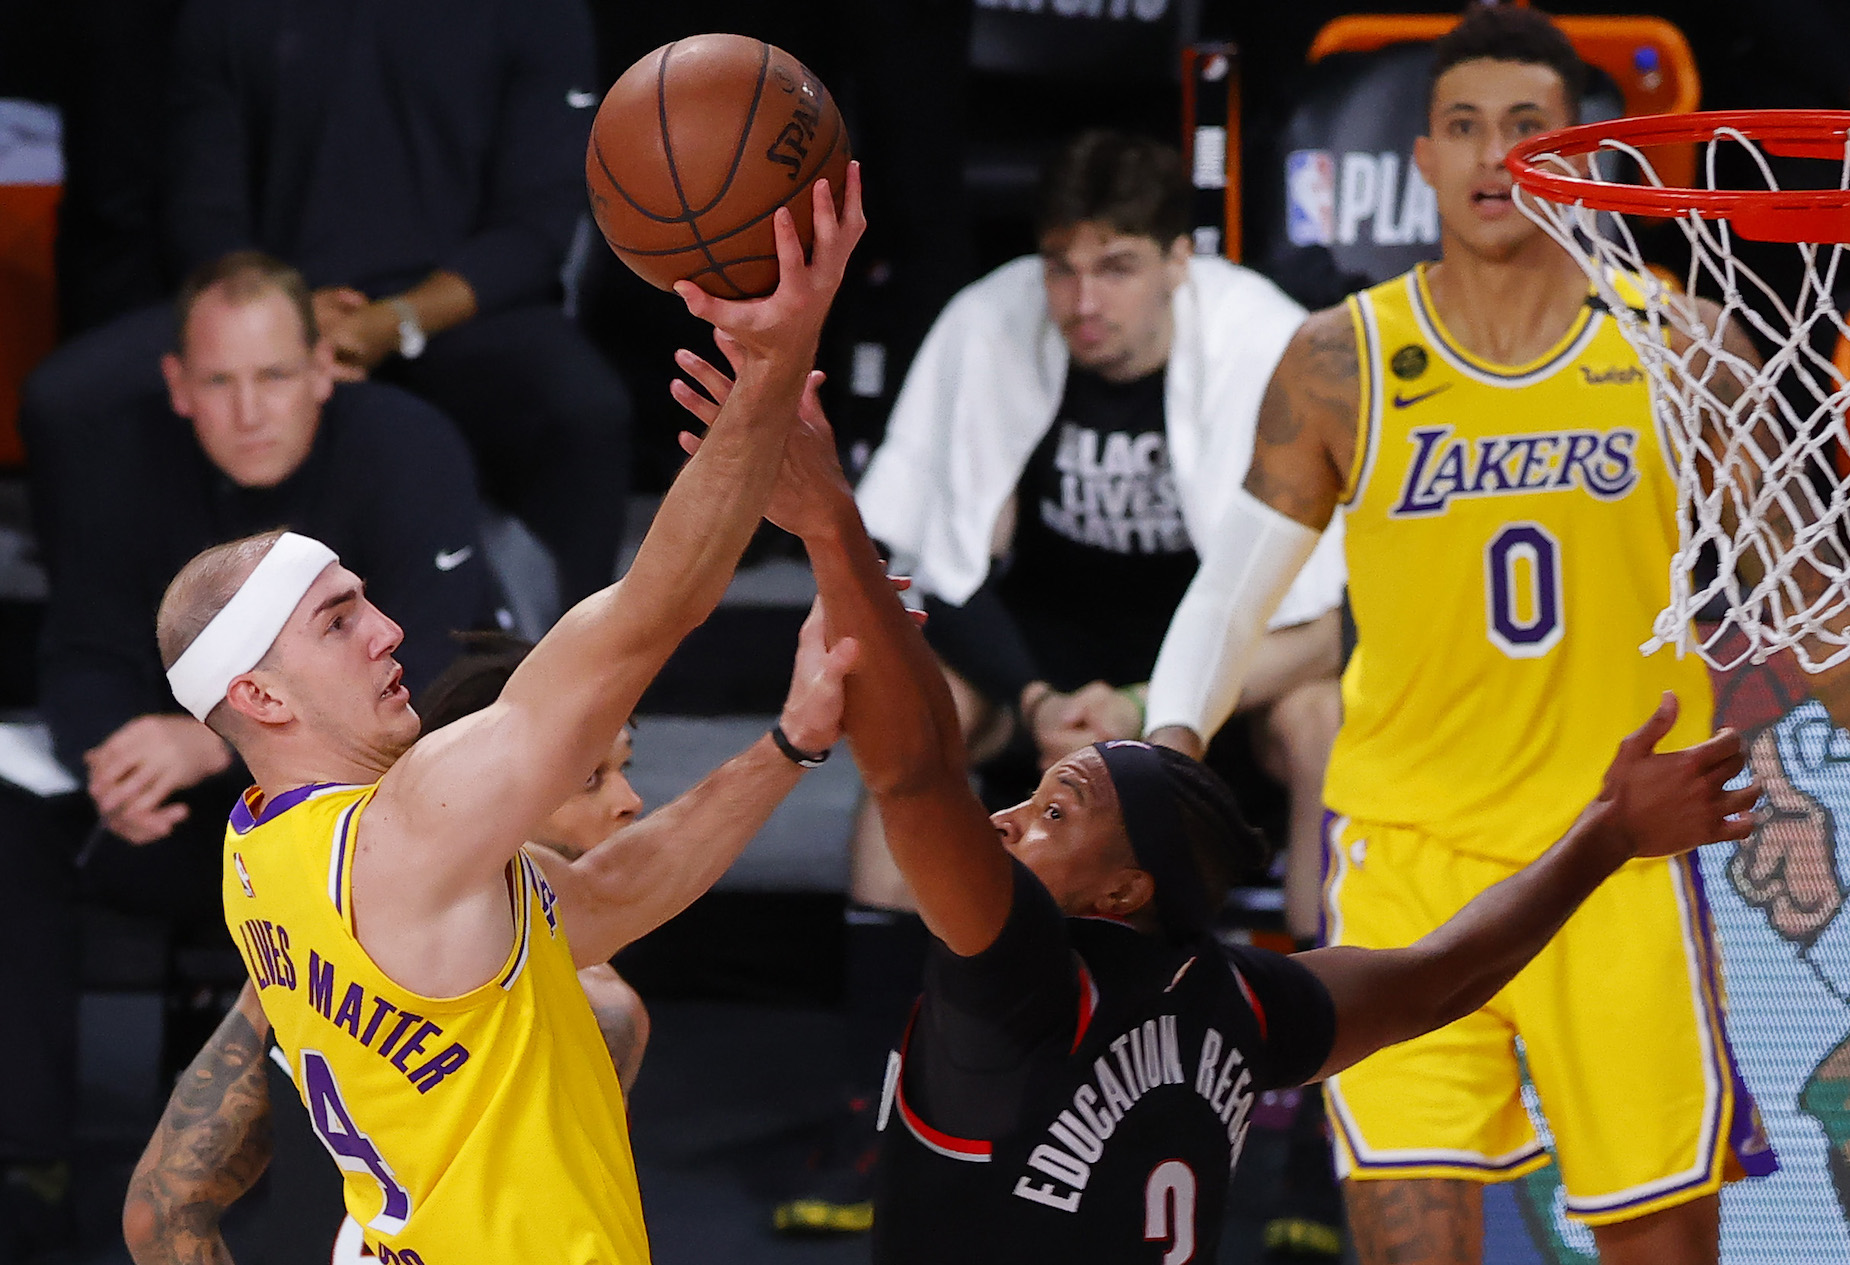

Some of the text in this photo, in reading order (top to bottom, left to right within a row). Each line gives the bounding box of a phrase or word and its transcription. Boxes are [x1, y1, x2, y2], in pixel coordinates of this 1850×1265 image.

[1338, 150, 1441, 245] PLA
[1390, 425, 1639, 518] LAKERS
[1484, 520, 1565, 659] 0
[239, 918, 470, 1095] LIVES MATTER
[300, 1048, 412, 1237] 4
[1012, 1014, 1185, 1213] EDUCATION
